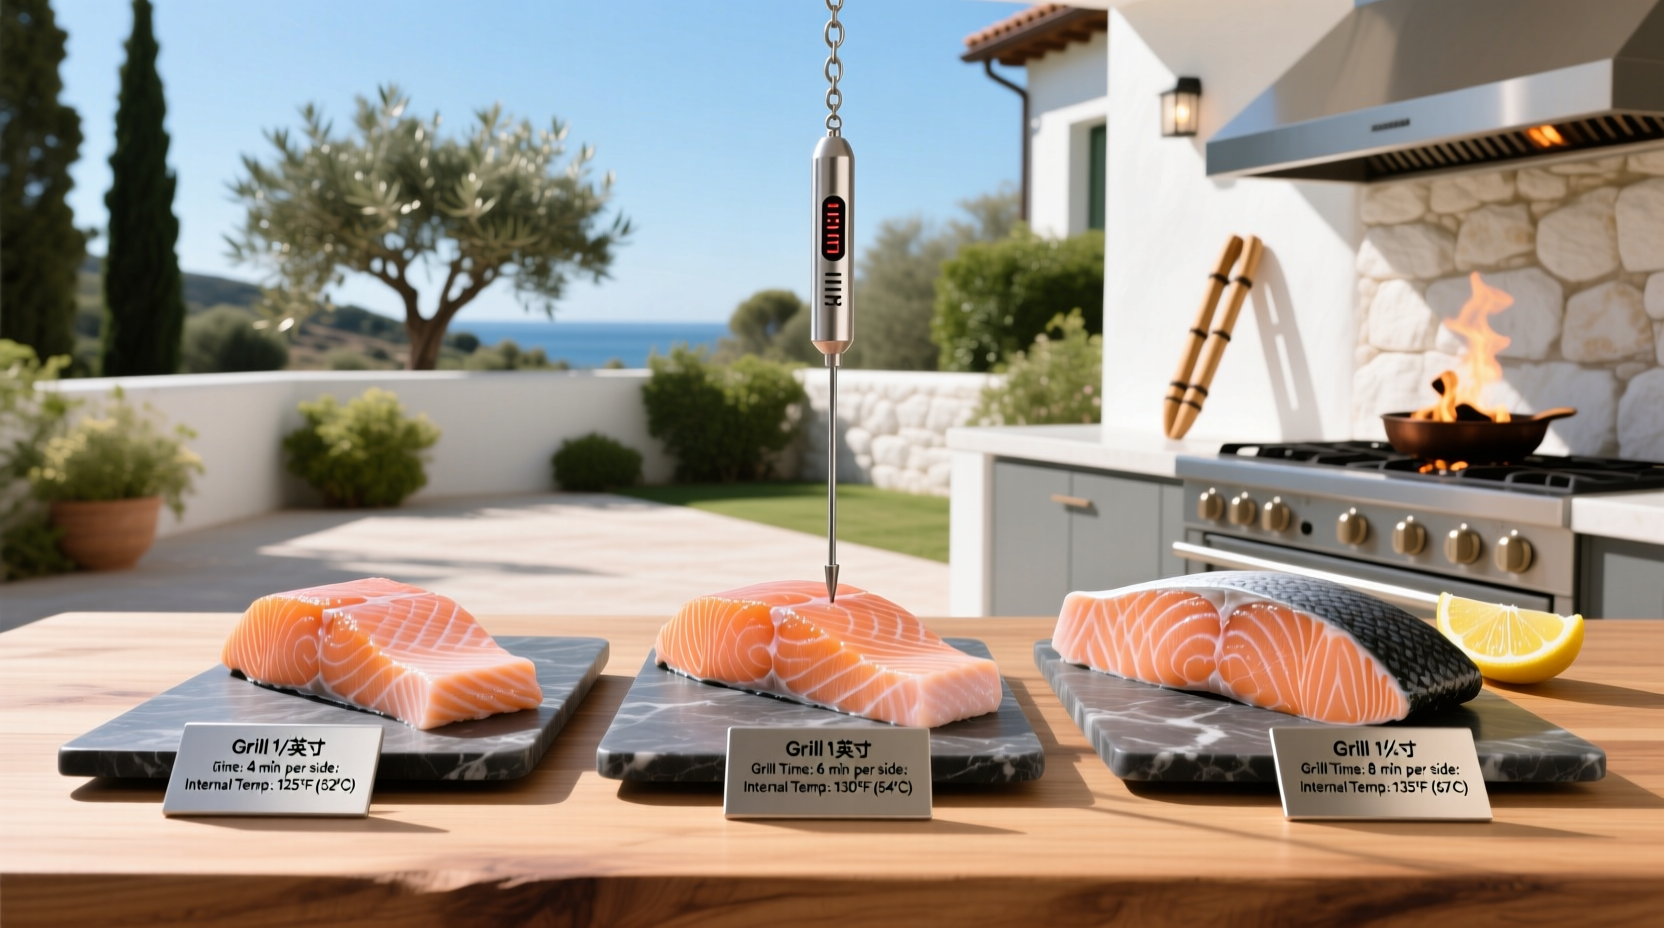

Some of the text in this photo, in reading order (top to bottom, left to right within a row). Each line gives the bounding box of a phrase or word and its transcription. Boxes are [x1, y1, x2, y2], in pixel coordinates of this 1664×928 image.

[232, 738, 269, 755] Grill
[786, 740, 823, 757] Grill
[1333, 740, 1369, 756] Grill
[247, 761, 255, 772] 4
[260, 761, 280, 773] min
[285, 764, 305, 777] per
[779, 763, 813, 775] Time:
[817, 762, 825, 774] 6
[829, 763, 849, 774] min
[855, 765, 875, 779] per
[1301, 762, 1328, 775] Grill
[1329, 762, 1365, 775] Time:
[1369, 762, 1376, 775] 8
[1381, 763, 1401, 775] min
[1407, 765, 1426, 778] per
[791, 781, 831, 796] Temp:
[1349, 781, 1389, 797] Temp:
